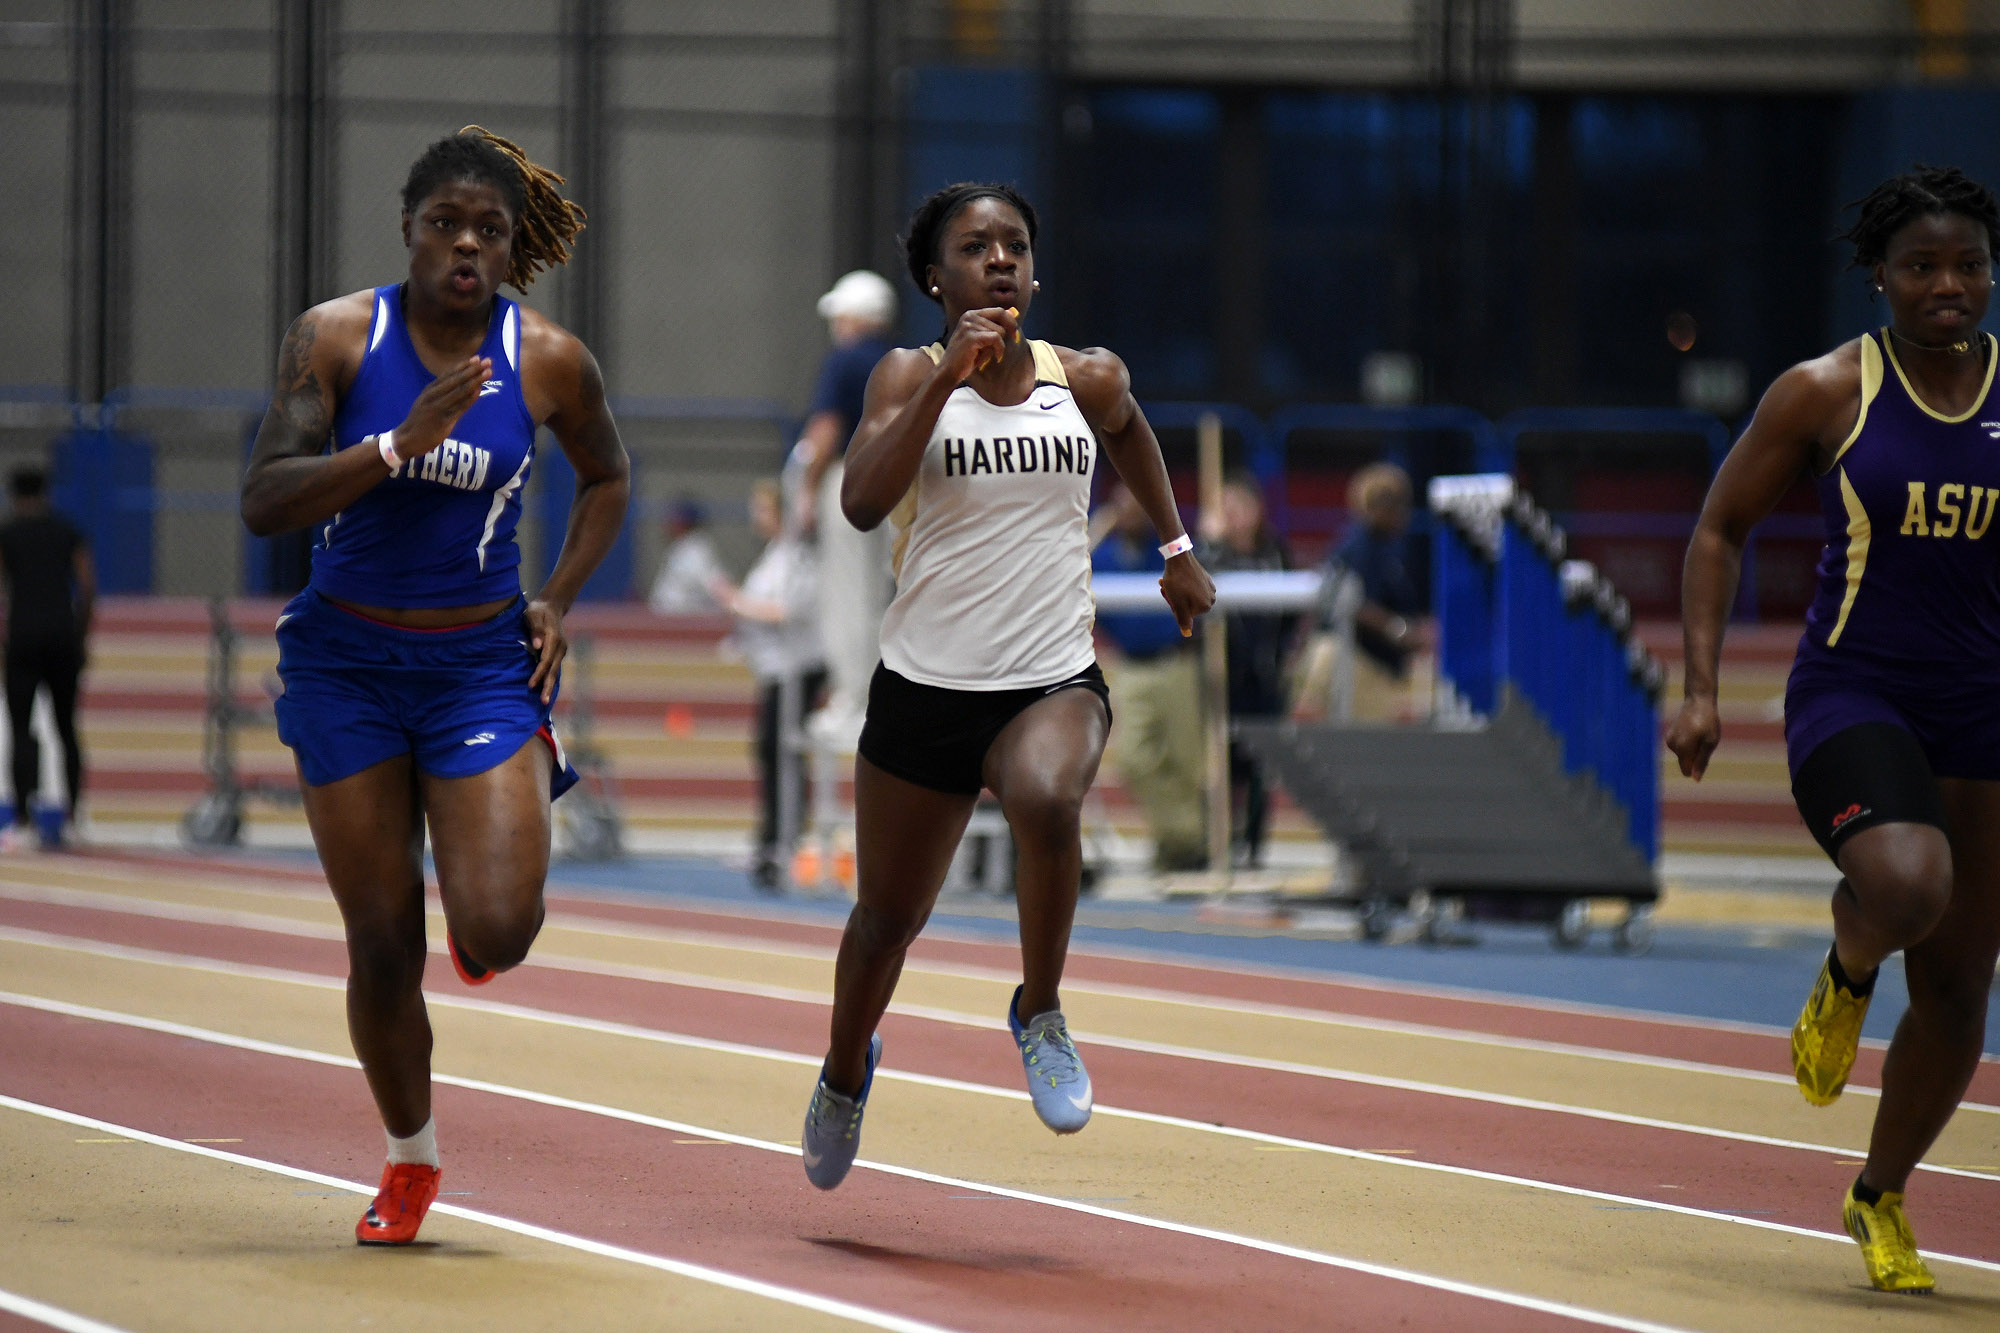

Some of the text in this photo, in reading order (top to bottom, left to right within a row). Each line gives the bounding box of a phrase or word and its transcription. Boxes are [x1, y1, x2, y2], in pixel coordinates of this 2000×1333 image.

[361, 434, 490, 491] HERN
[945, 435, 1090, 477] HARDING
[1900, 481, 2000, 540] ASU
